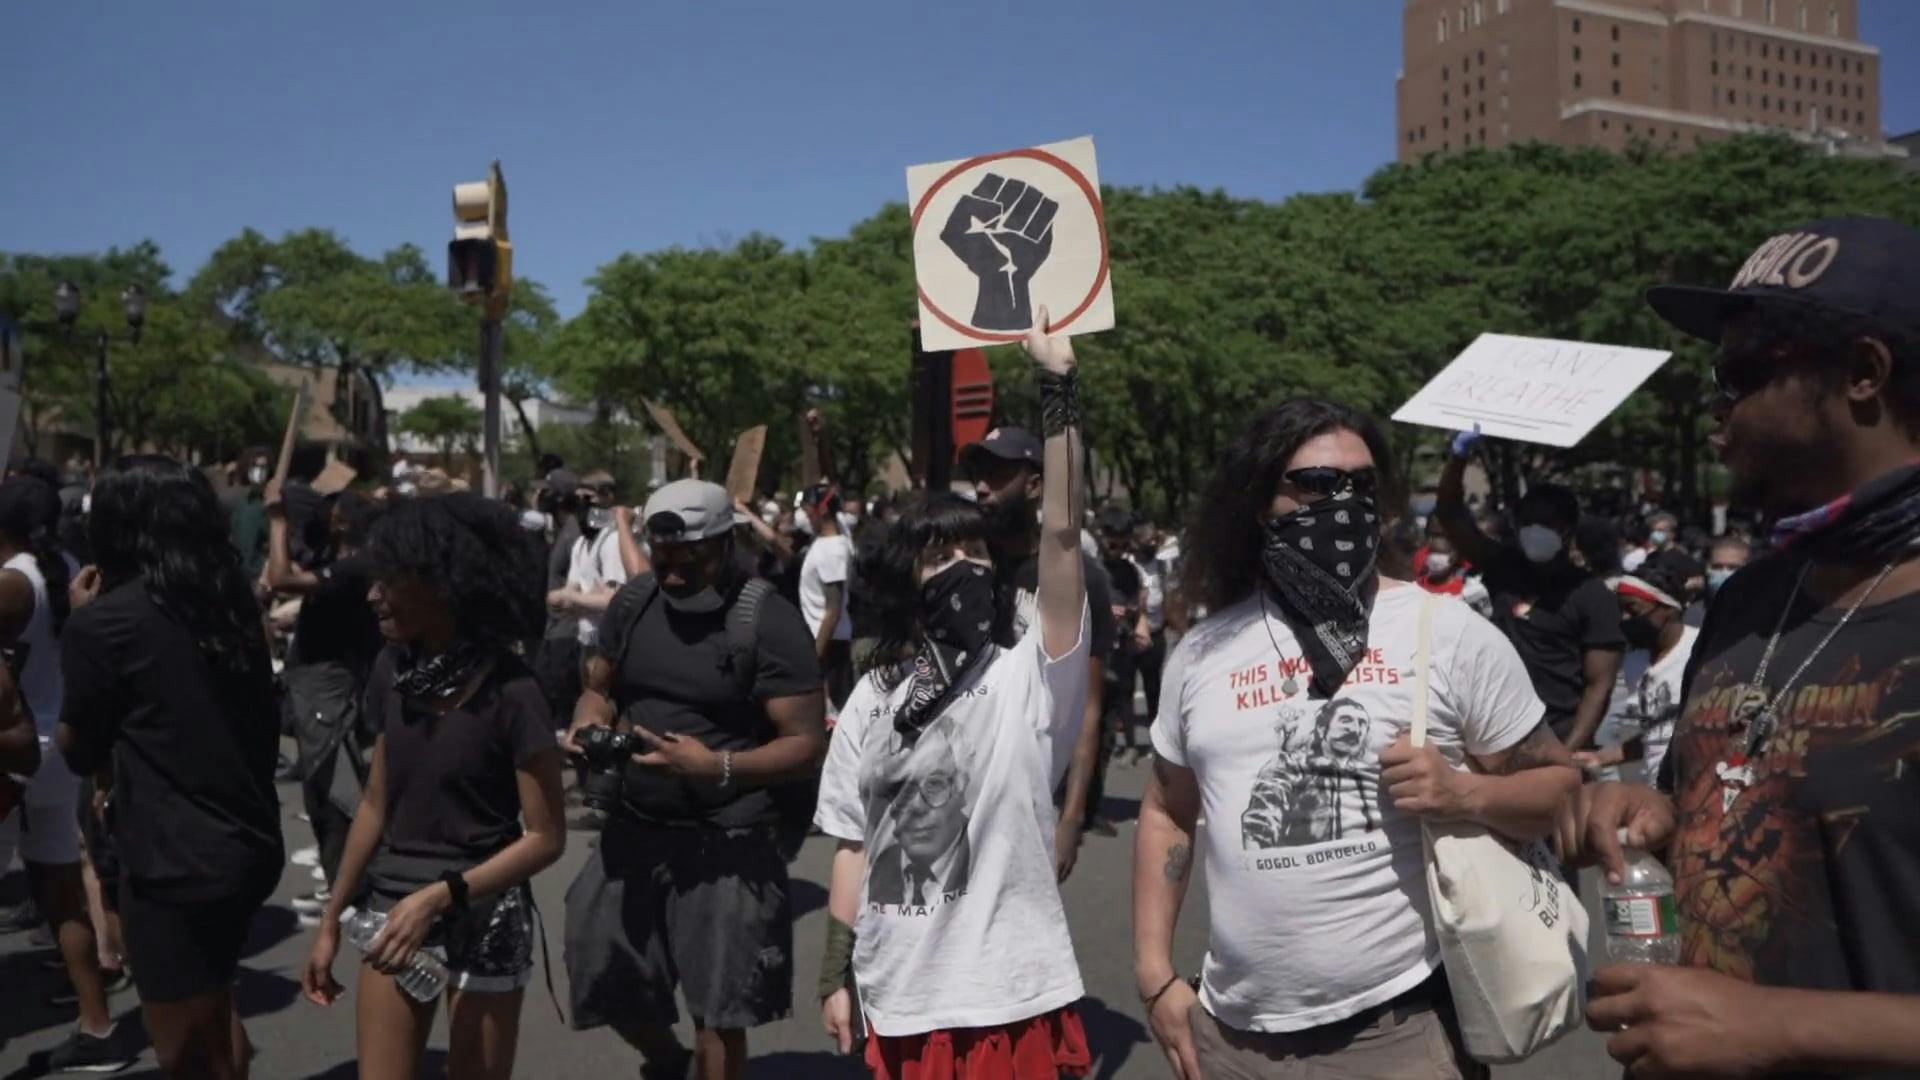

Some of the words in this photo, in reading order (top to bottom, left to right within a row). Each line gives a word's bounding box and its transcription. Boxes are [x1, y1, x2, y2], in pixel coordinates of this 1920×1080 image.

[1442, 369, 1605, 416] BREATHE
[1229, 664, 1267, 689] THIS
[1236, 685, 1297, 711] KILL
[1256, 857, 1302, 871] GOGOL
[1306, 841, 1377, 866] BORDELLO
